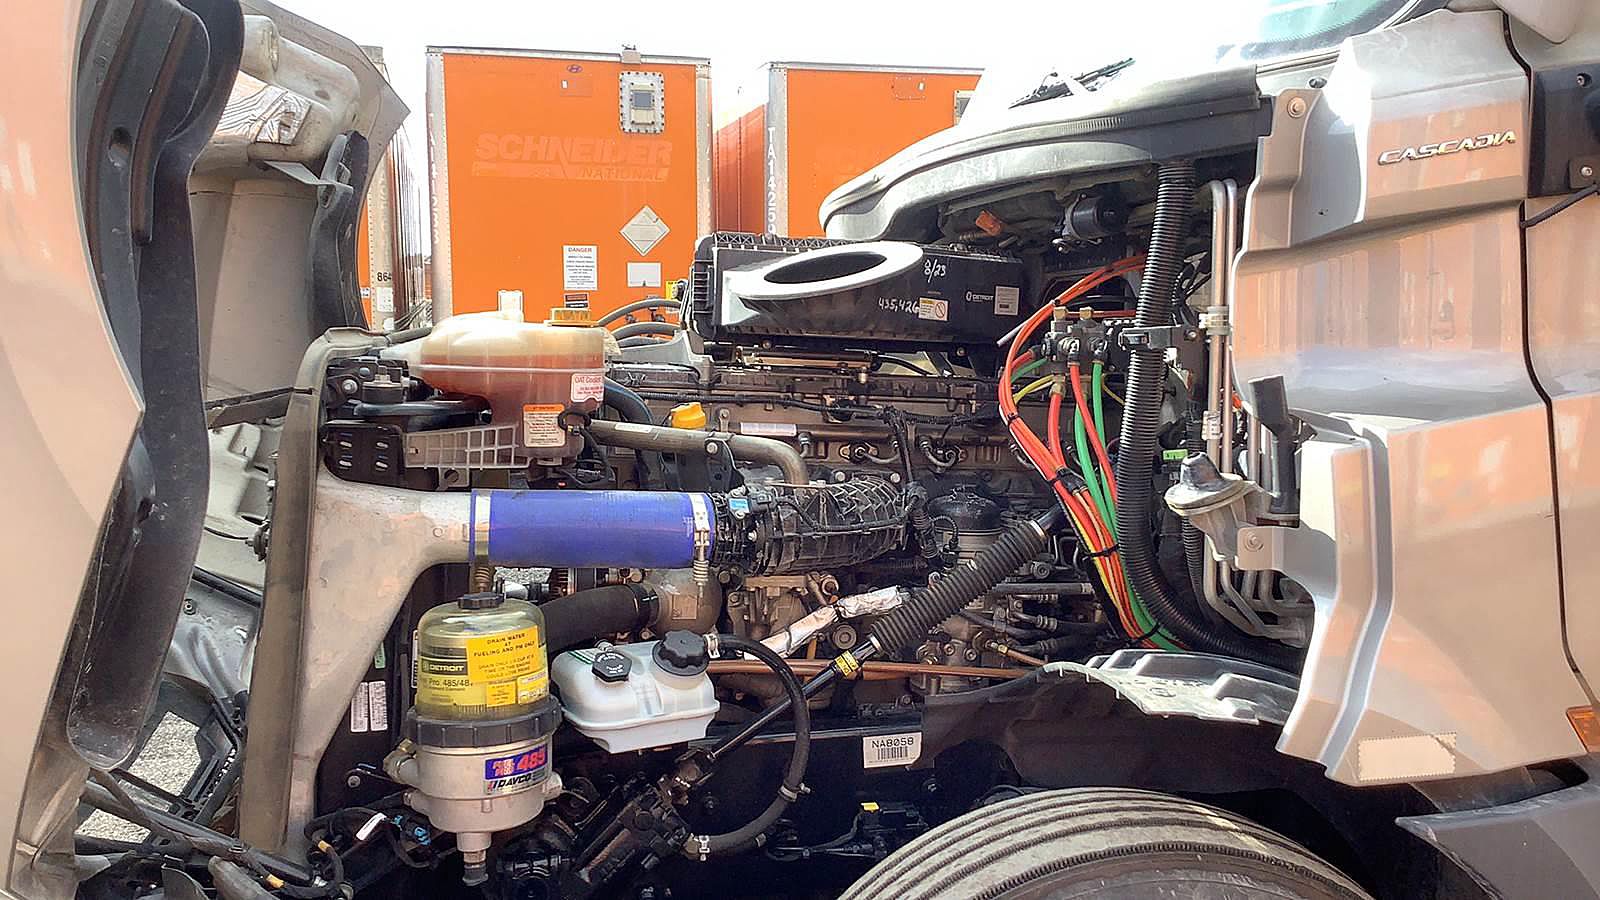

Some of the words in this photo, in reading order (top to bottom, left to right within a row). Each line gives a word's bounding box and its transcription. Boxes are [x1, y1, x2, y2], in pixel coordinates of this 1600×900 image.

[476, 133, 673, 166] SCHNEIDER
[1378, 130, 1516, 165] CASCADIA
[580, 166, 664, 181] NATIONAL
[924, 258, 946, 283] 8/23
[473, 648, 501, 657] FUELING
[429, 662, 465, 672] DETROIT
[443, 679, 473, 687] 485/48
[872, 737, 914, 748] NA8058
